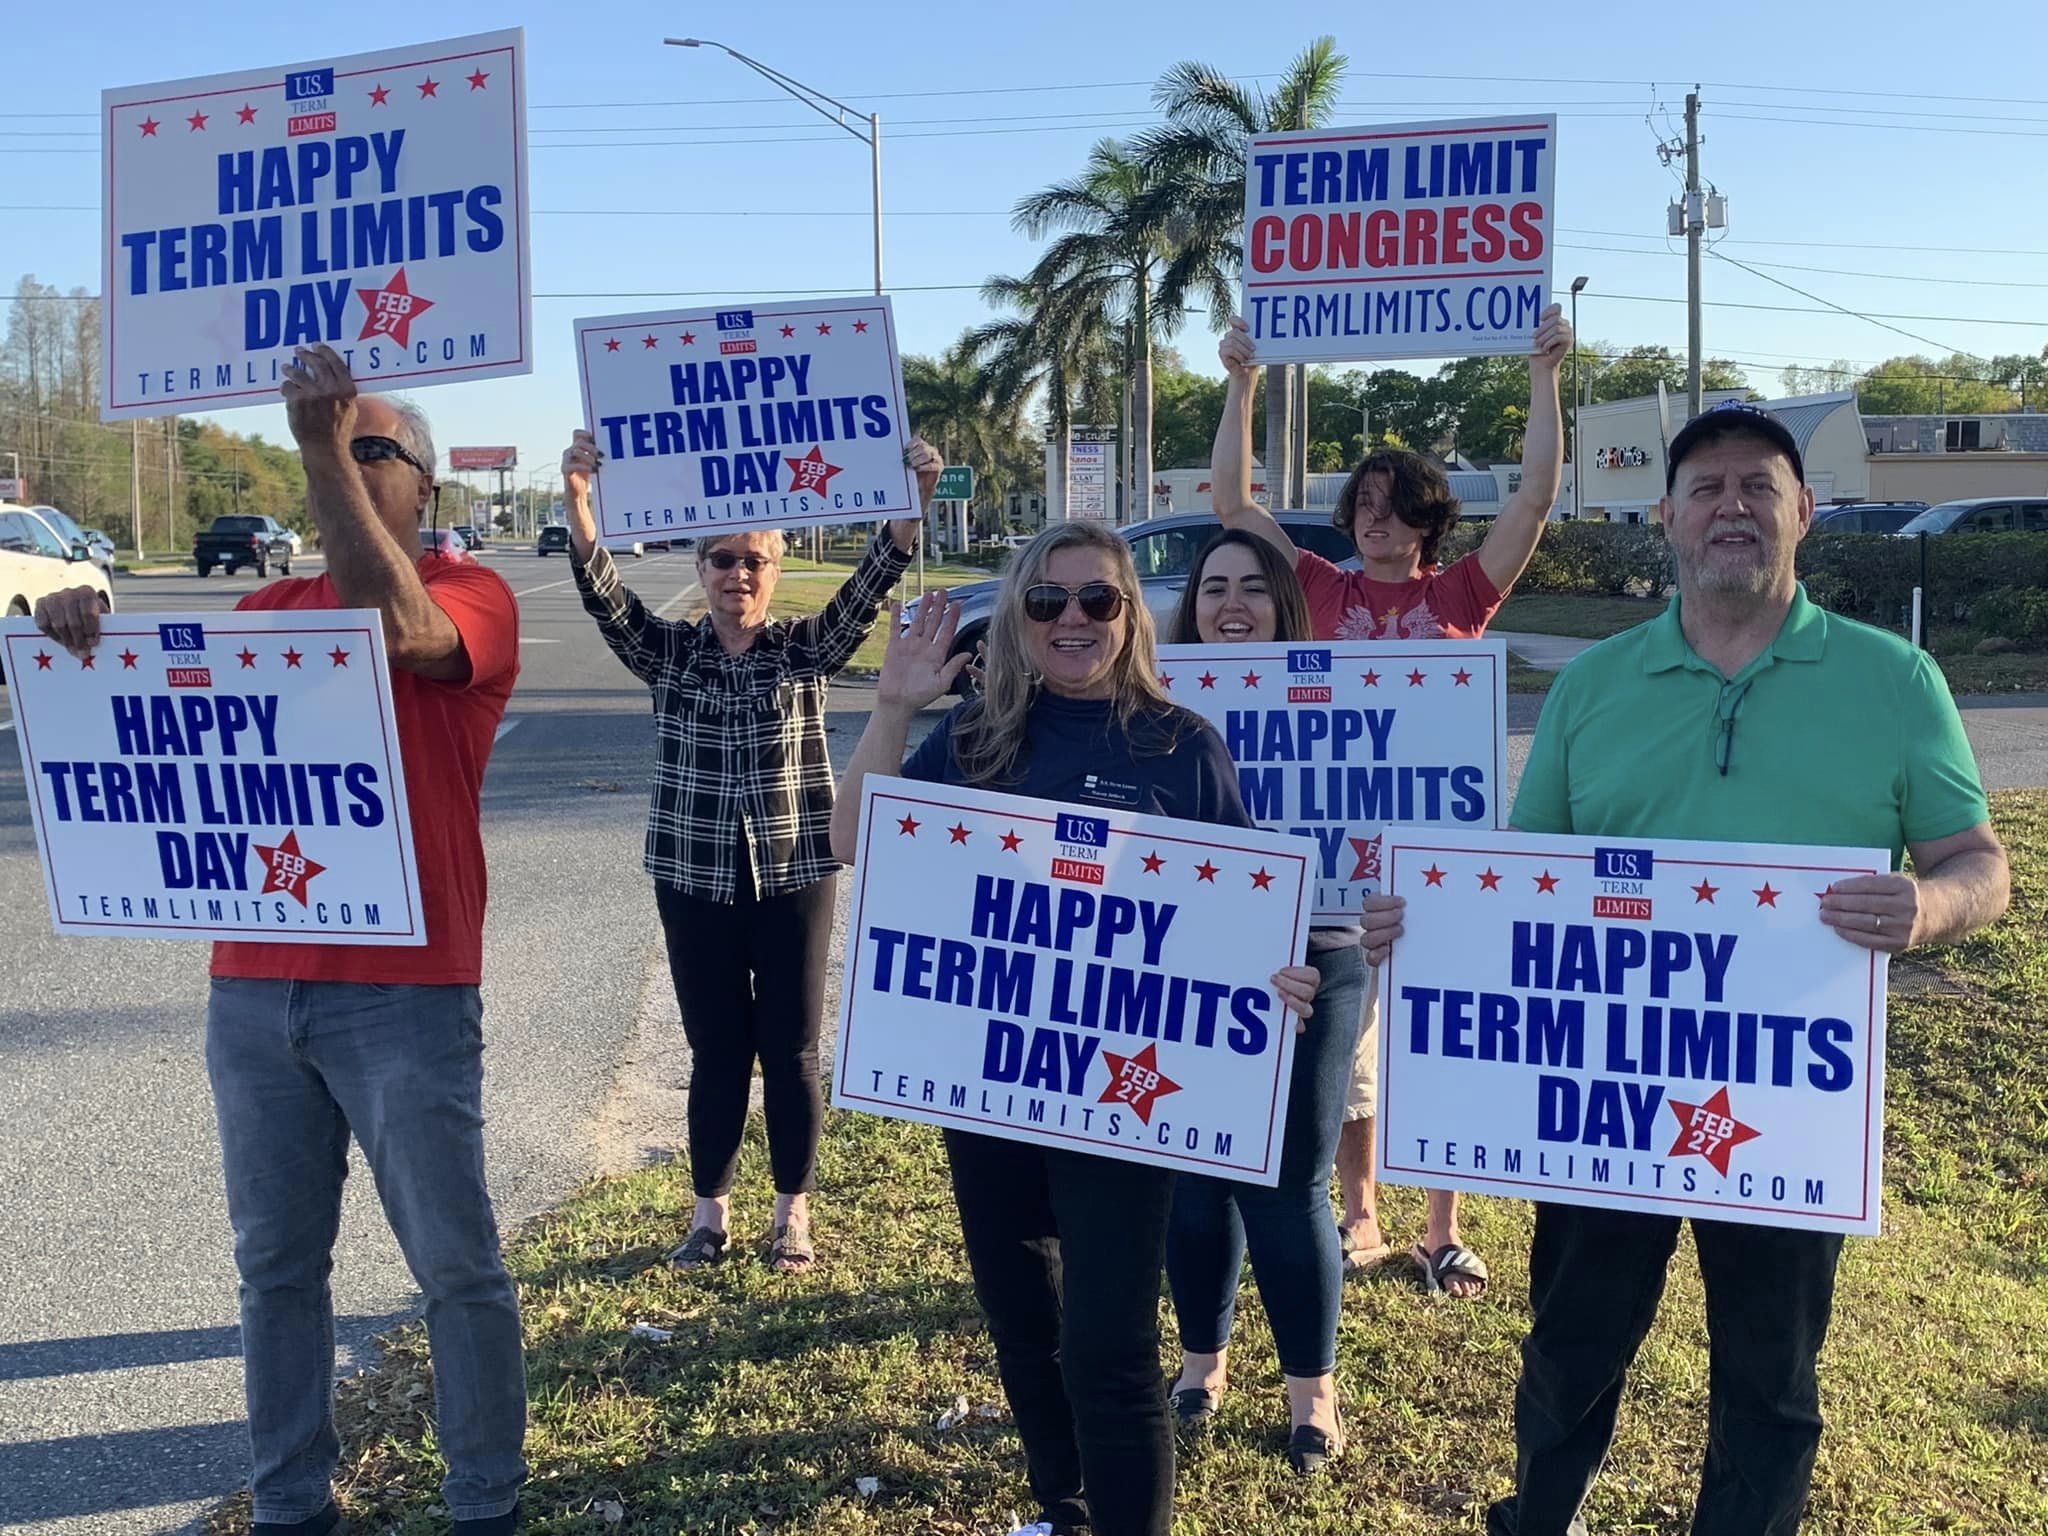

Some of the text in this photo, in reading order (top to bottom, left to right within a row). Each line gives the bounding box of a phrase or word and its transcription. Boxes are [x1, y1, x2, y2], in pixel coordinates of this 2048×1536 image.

[294, 74, 324, 96] U.S.
[290, 97, 327, 114] TERM
[290, 114, 335, 134] LIMITS
[218, 129, 405, 215] HAPPY
[1254, 138, 1546, 207] TERM LIMIT
[122, 185, 504, 295] TERM LIMITS
[1251, 202, 1543, 273] CONGRESS
[245, 278, 352, 351] DAY
[375, 291, 412, 314] FEB
[1251, 285, 1541, 339] TERMLIMITS.COM
[373, 312, 400, 332] 27
[724, 313, 747, 327] U.S.
[721, 341, 756, 354] LIMITS
[139, 333, 487, 395] TERMLITS.COM
[670, 354, 811, 406] HAPPY
[600, 395, 891, 460] TERM LIMITS
[700, 450, 781, 498] DAY
[799, 460, 828, 476] FEB
[800, 474, 821, 488] 27
[941, 474, 965, 482] ane
[625, 491, 888, 528] TERMLIMITS.COM
[169, 628, 196, 649] U.S.
[169, 653, 201, 665] TERM
[1296, 654, 1322, 671] U.S.
[167, 668, 210, 686] LIMITS
[1293, 674, 1325, 685] TERM
[1290, 689, 1330, 701] LIMITS
[111, 695, 278, 756] HAPPY
[1226, 709, 1396, 761] HAPPY
[41, 762, 384, 827] TERM LIMITS
[1300, 766, 1485, 822] LIMITS
[1066, 820, 1096, 843] U.S.
[156, 831, 248, 890] DAY
[272, 852, 306, 874] FEB
[1060, 845, 1098, 860] TERM
[1607, 854, 1640, 877] U.S.
[274, 871, 299, 888] 27
[1053, 862, 1102, 882] LIMITS
[1601, 881, 1643, 894] TERM
[80, 896, 381, 925] TERMLIMITS.COM
[971, 874, 1178, 966] HAPPY
[1596, 900, 1649, 917] LIMITS
[1512, 921, 1738, 1002] HAPPY
[869, 927, 1270, 1055] TERM LIMITS
[1402, 986, 1853, 1091] TERM LIMITS
[982, 1019, 1100, 1096] DAY
[1119, 1062, 1160, 1091] FEB
[1115, 1082, 1146, 1105] 27
[871, 1070, 1232, 1156] TERMLIMITS.COM
[1538, 1075, 1665, 1151] DAY
[1689, 1109, 1735, 1139] FEB
[1688, 1133, 1721, 1156] 27
[1417, 1140, 1824, 1205] TERMLIMITS.COM
